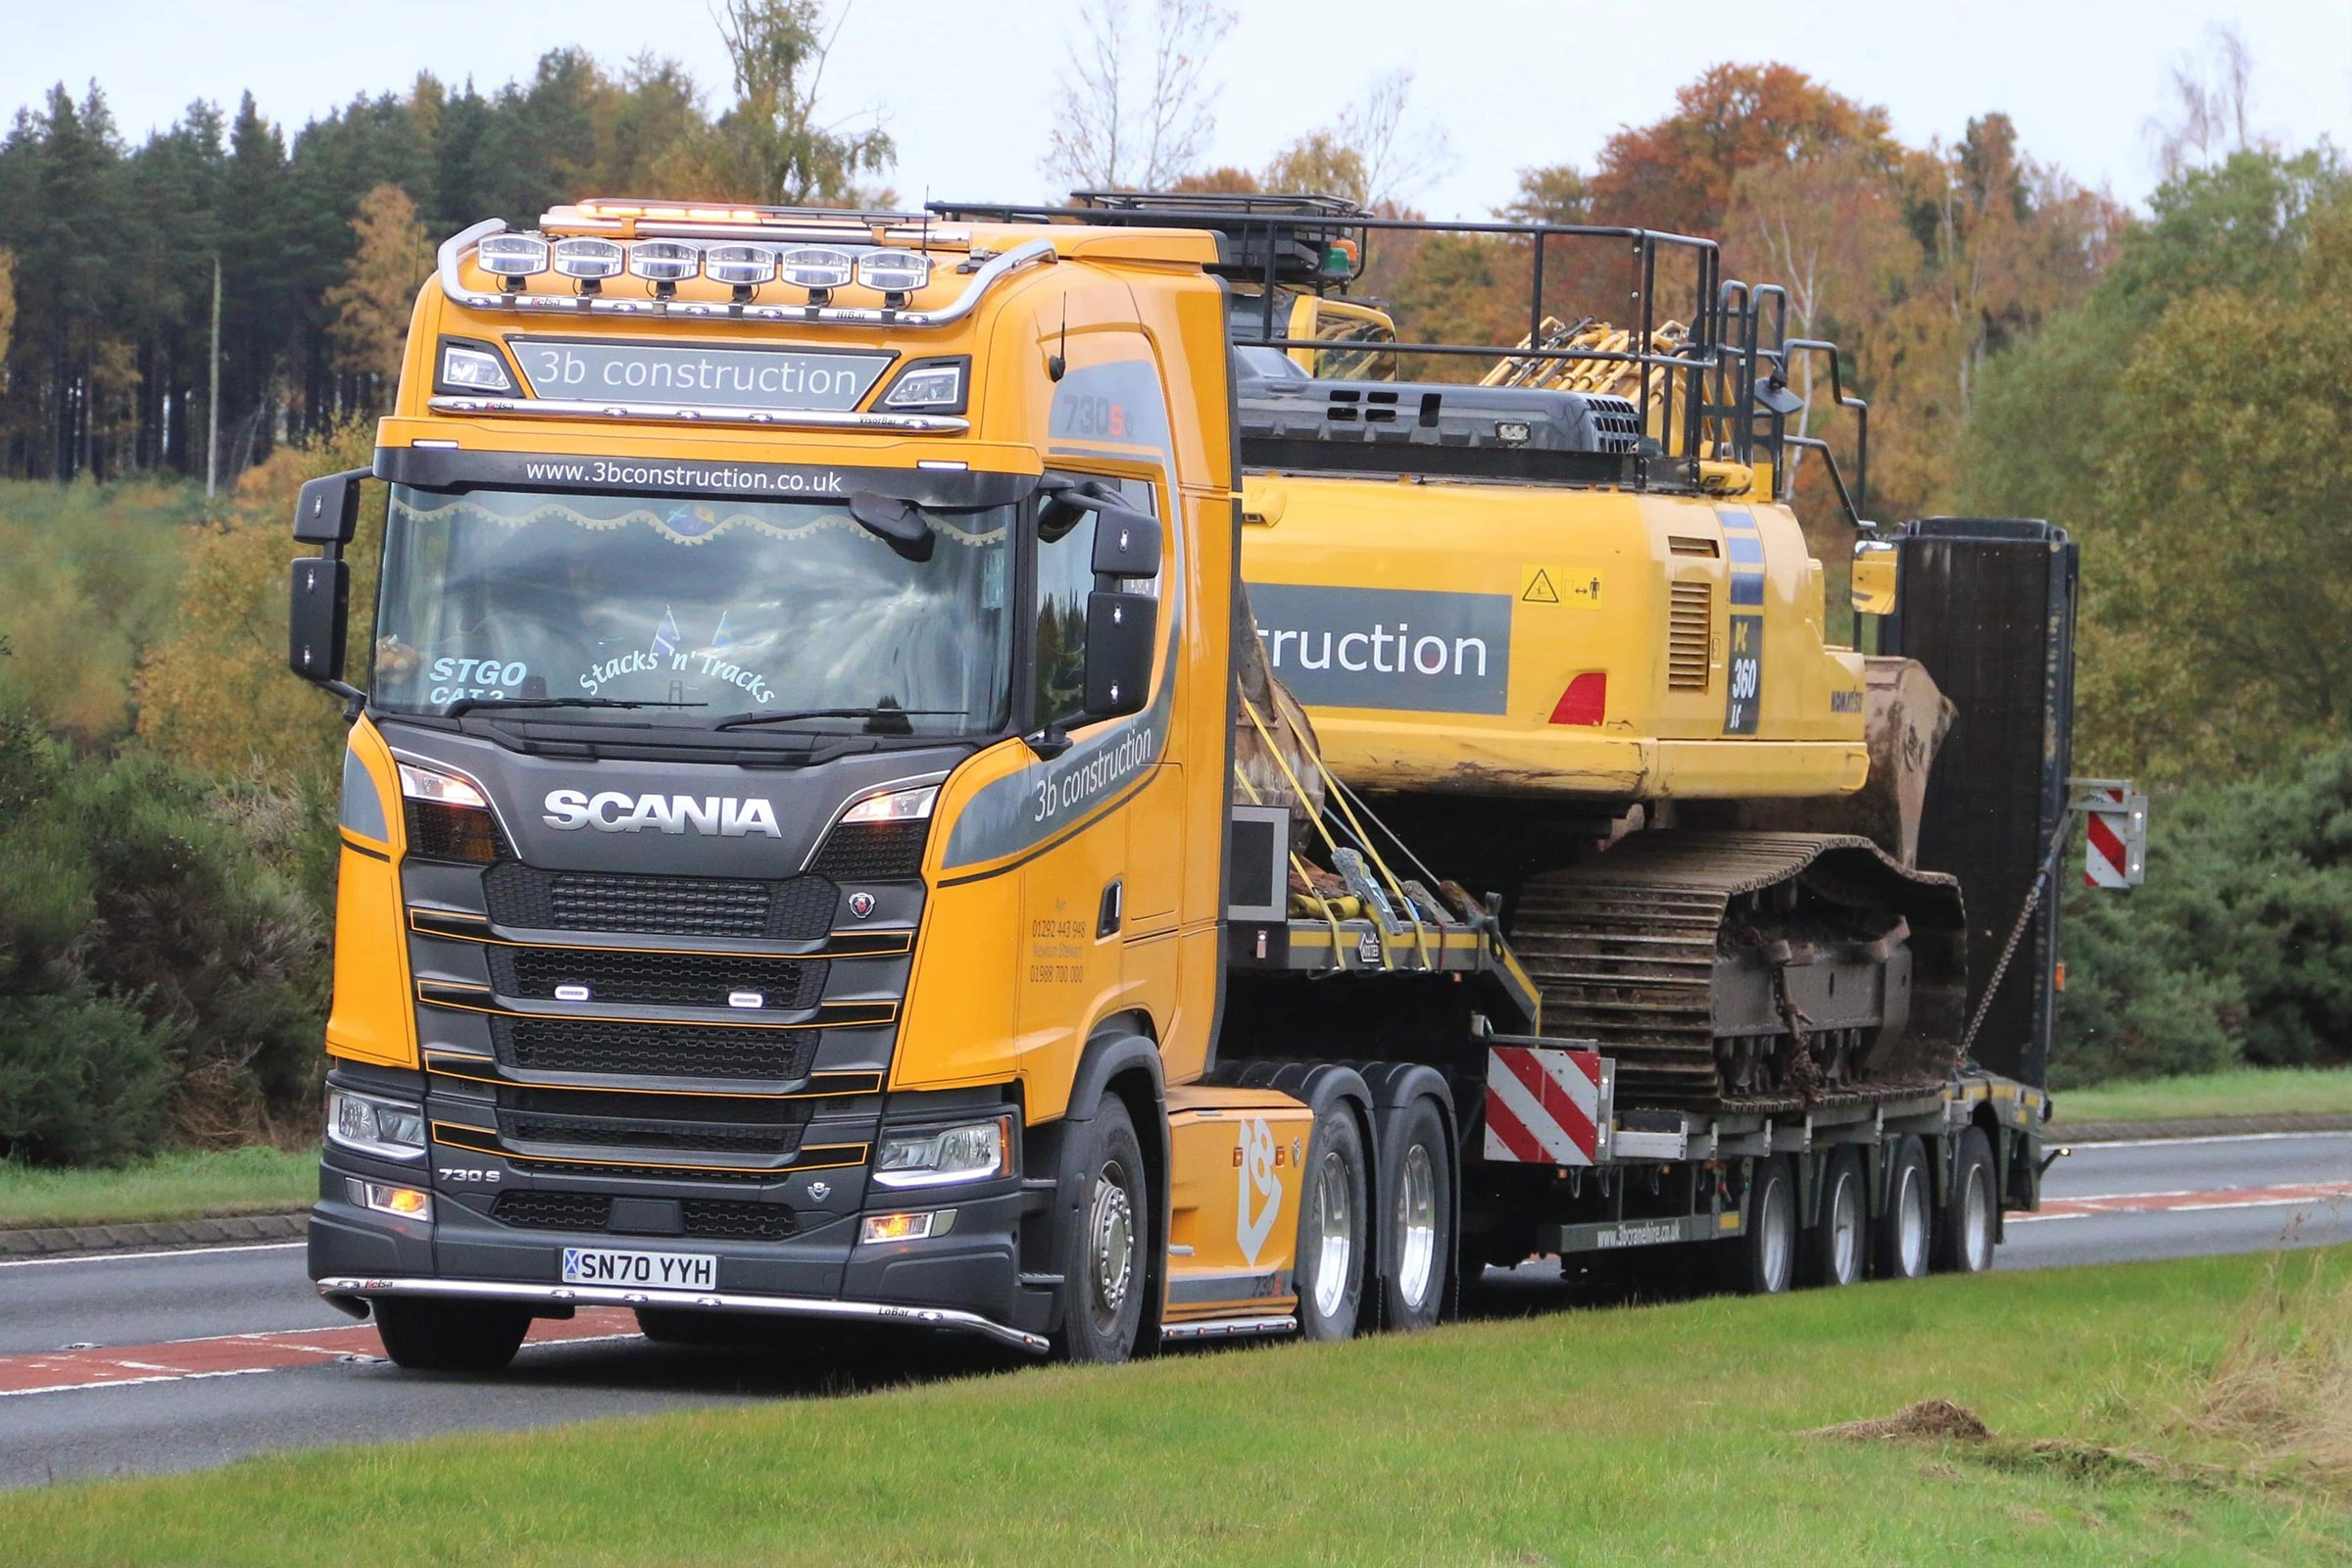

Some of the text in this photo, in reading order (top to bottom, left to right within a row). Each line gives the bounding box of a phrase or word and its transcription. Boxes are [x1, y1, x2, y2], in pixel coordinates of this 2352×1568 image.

[537, 351, 856, 395] 3b construction
[526, 461, 842, 492] www.3bconstruction.co.uk
[428, 658, 527, 687] STGO
[579, 650, 660, 696] Stacks
[701, 654, 775, 704] Tracks
[1733, 659, 1756, 699] 360
[1035, 728, 1152, 821] 3b construction
[542, 790, 782, 839] SCANIA
[581, 1253, 710, 1285] SN70 YYH
[878, 1306, 909, 1317] LoBar
